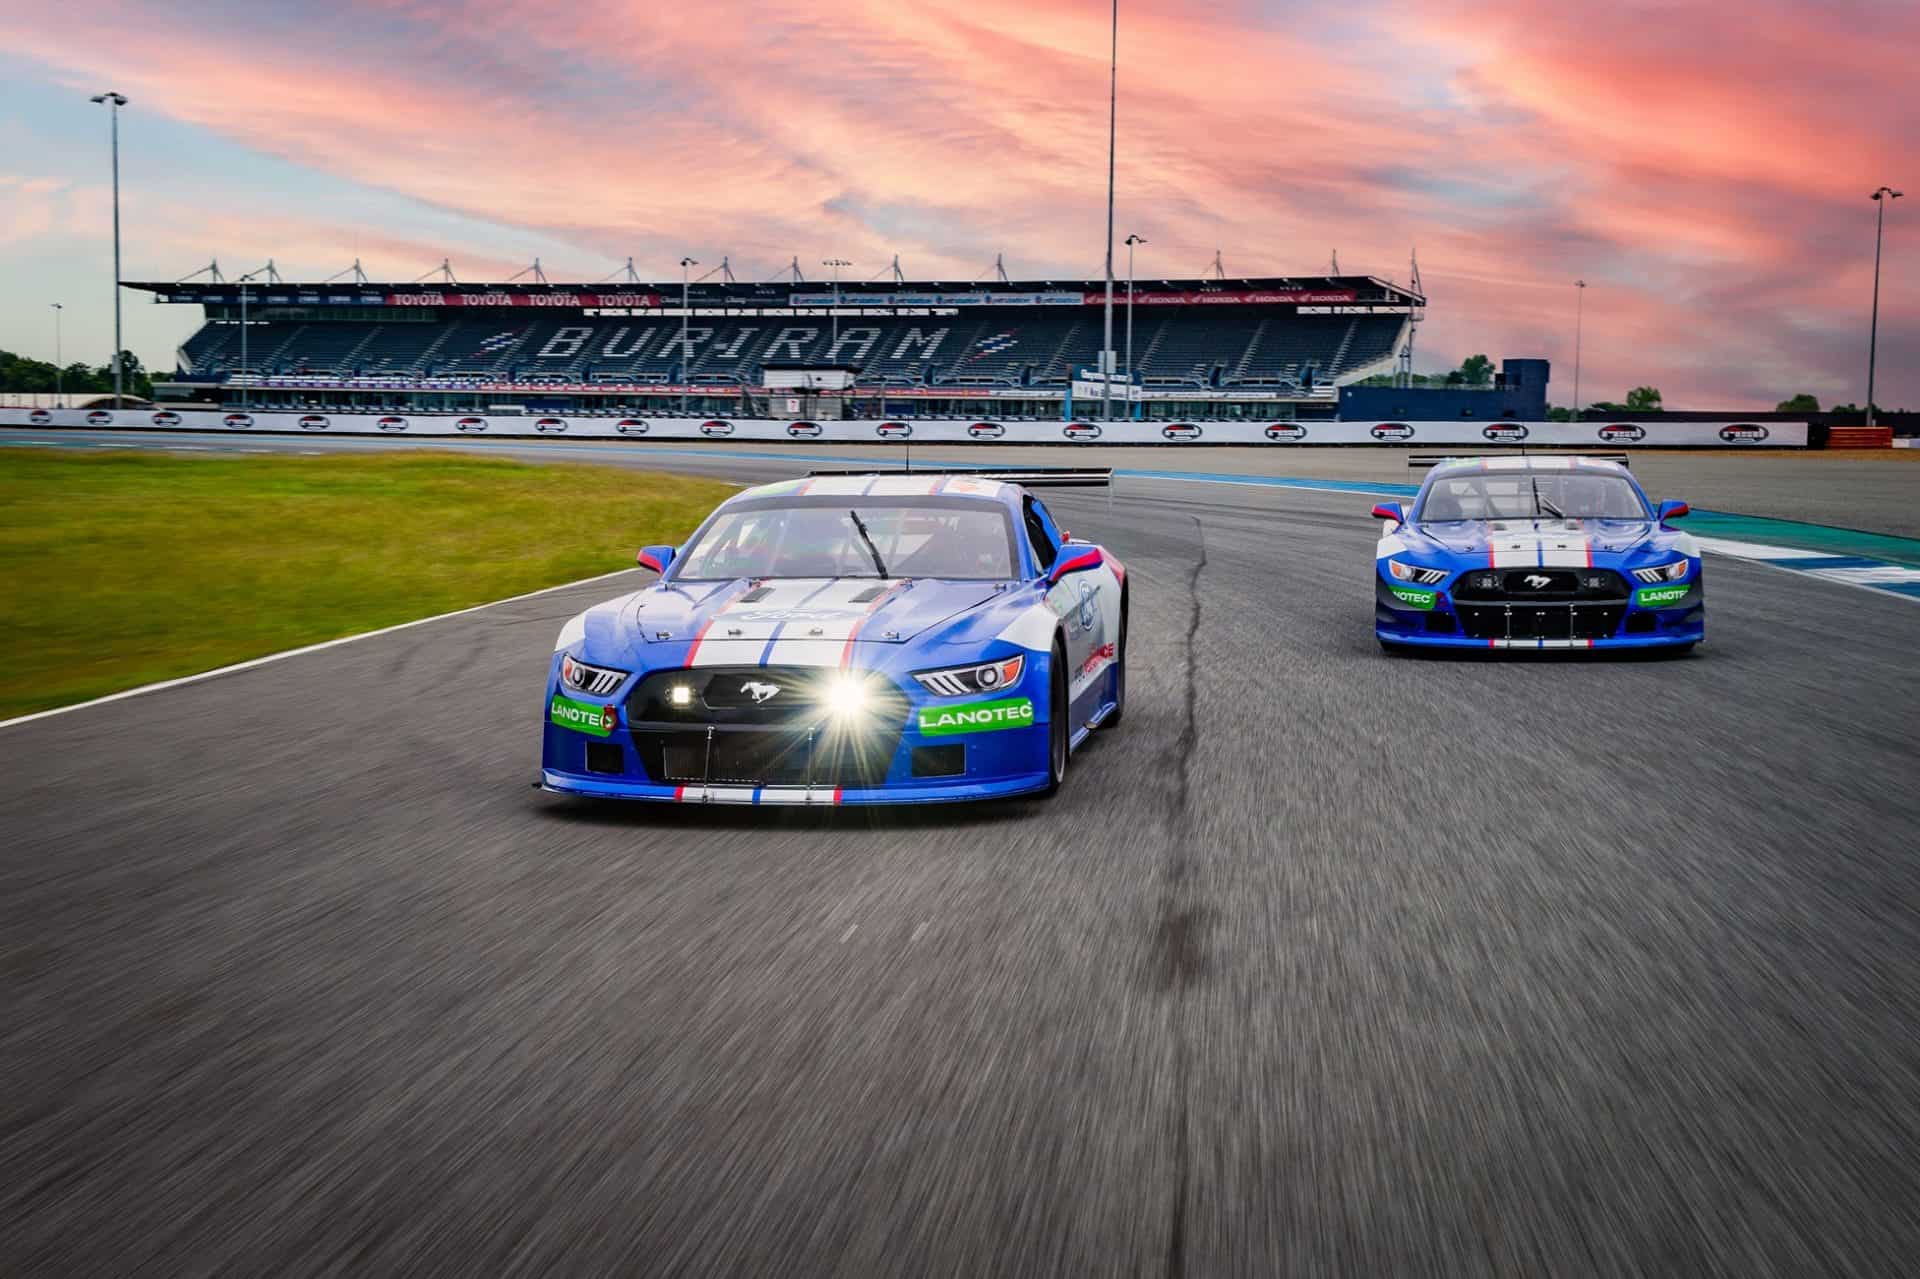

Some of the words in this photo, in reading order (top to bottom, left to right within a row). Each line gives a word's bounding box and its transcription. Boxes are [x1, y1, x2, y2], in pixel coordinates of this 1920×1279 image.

[394, 294, 445, 306] TOYOTA
[461, 294, 513, 306] TOYOTA
[528, 294, 581, 306] TOYOTA
[596, 294, 651, 306] TOYOTA
[1149, 296, 1186, 304] HONDA
[1255, 295, 1295, 303] HONDA
[1311, 295, 1351, 303] HONDA
[538, 327, 950, 359] BURIRAM
[552, 702, 614, 729] LANOTEC
[919, 703, 1033, 728] LANOTEC
